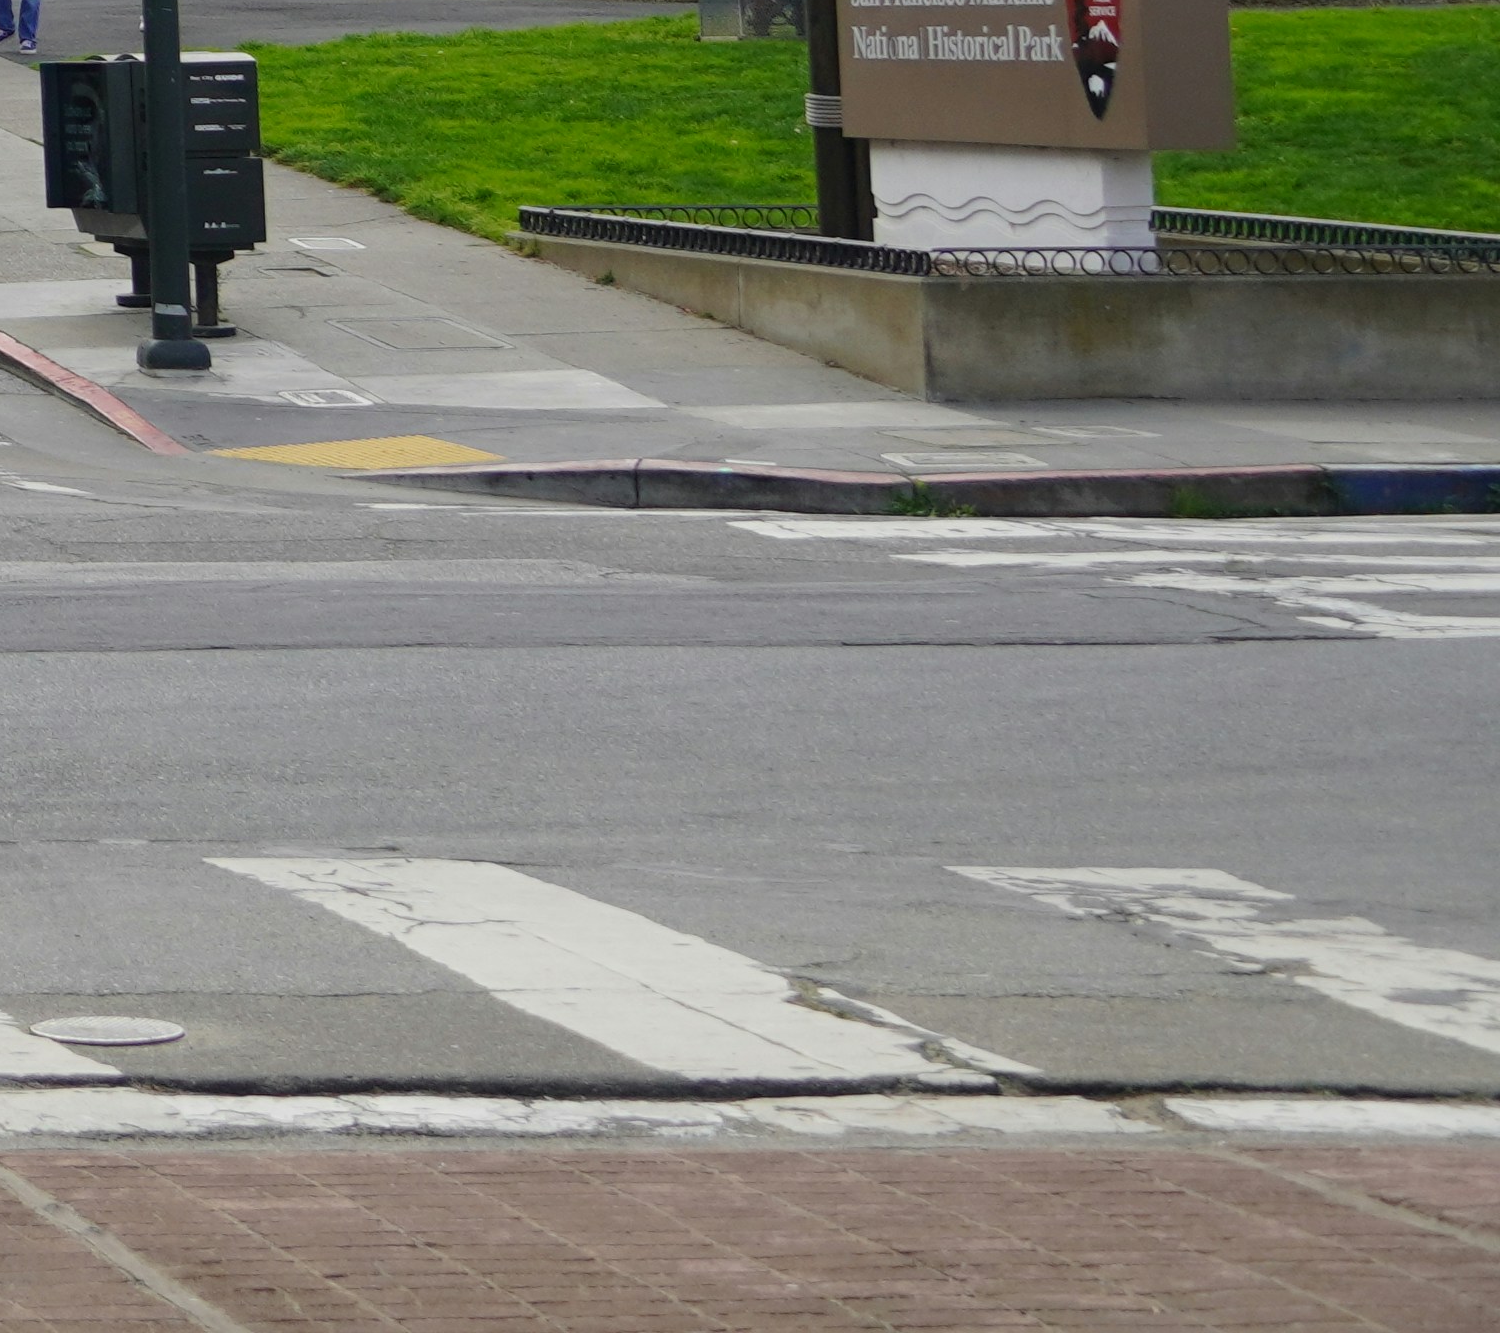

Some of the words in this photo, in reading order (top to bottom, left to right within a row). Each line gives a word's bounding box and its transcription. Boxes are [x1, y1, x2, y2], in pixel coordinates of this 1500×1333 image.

[851, 24, 926, 60] National
[926, 23, 1015, 61] Historical
[1017, 24, 1065, 62] Park
